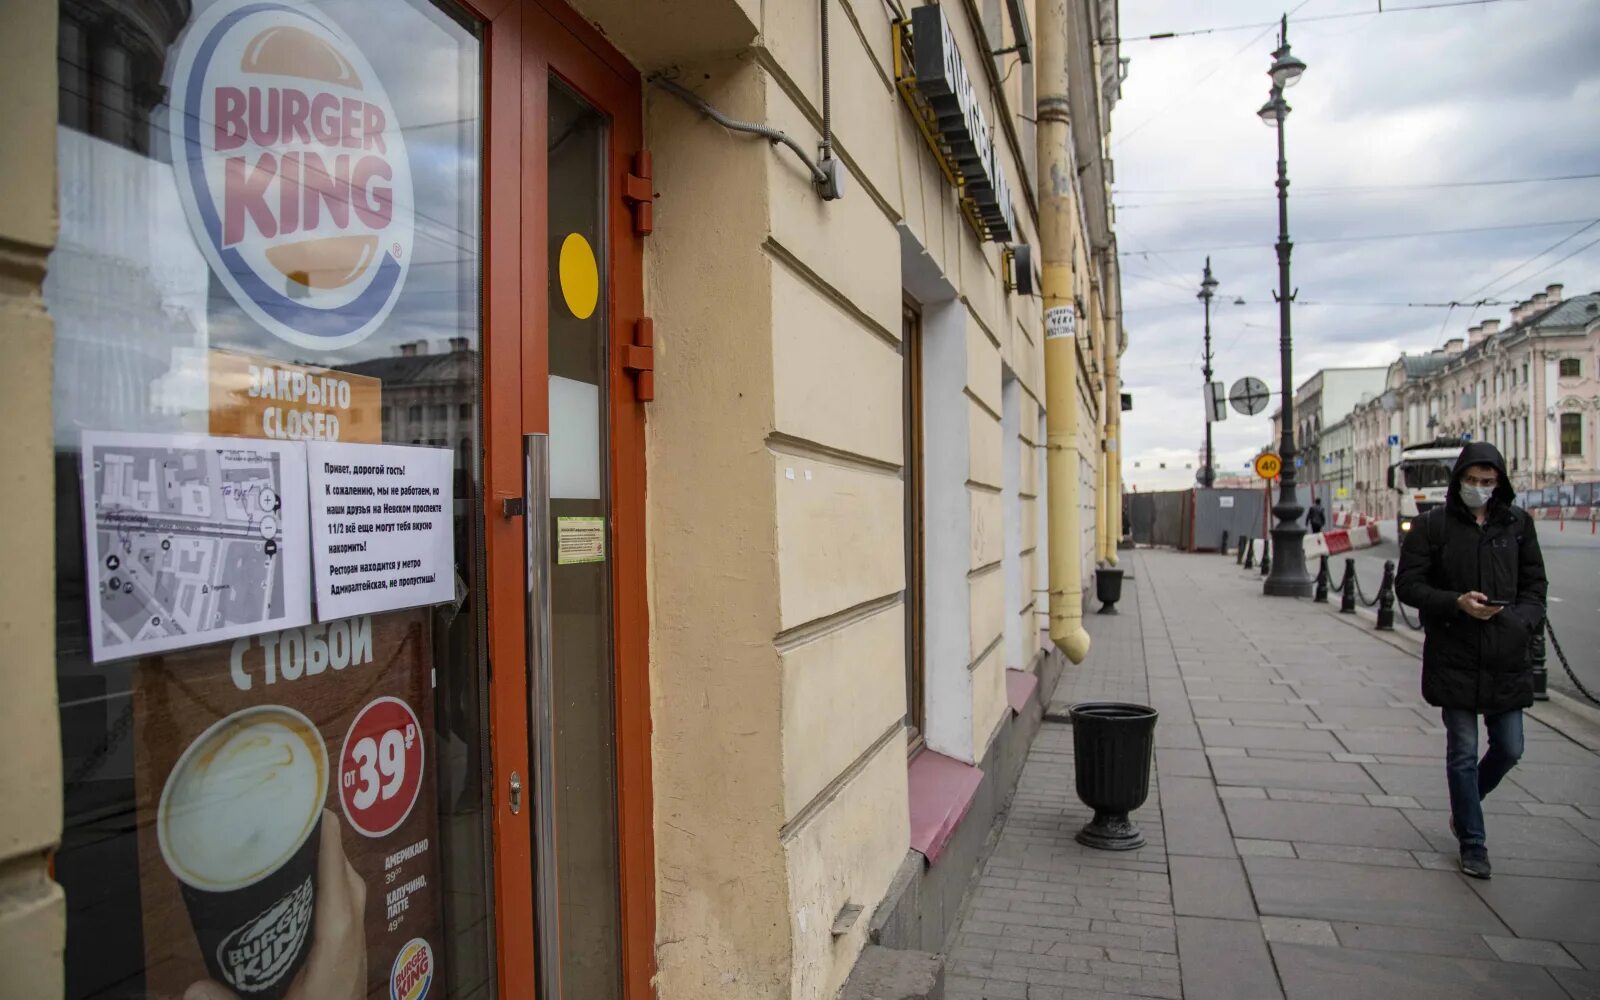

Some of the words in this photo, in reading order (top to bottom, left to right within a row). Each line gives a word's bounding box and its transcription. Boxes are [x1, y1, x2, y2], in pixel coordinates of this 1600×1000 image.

[215, 86, 387, 155] BURGER
[224, 151, 393, 246] KING
[248, 365, 351, 410] ЗАКРЫТО
[263, 406, 340, 441] CLOSED
[324, 462, 352, 475] Привет,
[353, 465, 385, 475] дорогой
[386, 465, 406, 476] гость!
[1261, 461, 1277, 471] 40
[325, 484, 331, 496] К
[332, 486, 375, 497] сожалению,
[377, 487, 389, 496] мы
[390, 487, 399, 496] не
[400, 486, 432, 497] работаем,
[432, 487, 440, 496] но
[327, 505, 345, 515] наши
[346, 505, 371, 516] друзья
[373, 505, 382, 515] на
[383, 503, 412, 514] Невском
[412, 504, 442, 514] проспекте
[328, 523, 344, 535] 11/2
[345, 523, 356, 534] всё
[357, 524, 374, 534] еще
[376, 523, 396, 533] могут
[396, 521, 411, 531] тебя
[412, 521, 433, 531] вкусно
[328, 541, 367, 554] накормить!
[329, 564, 359, 576] Ресторан
[359, 561, 396, 573] находится
[396, 561, 401, 571] у
[402, 559, 421, 569] метро
[330, 580, 388, 596] Адмиралтейская,
[389, 579, 398, 588] не
[398, 573, 436, 587] пропустишь!
[230, 639, 252, 691] С
[344, 770, 356, 788] ОТ
[384, 838, 429, 871] АМЕРИКАНО
[386, 874, 427, 906] КАПУЧИНО,
[387, 896, 409, 920] ЛАТТЕ
[396, 946, 427, 989] BURGER
[398, 956, 429, 1000] KING
